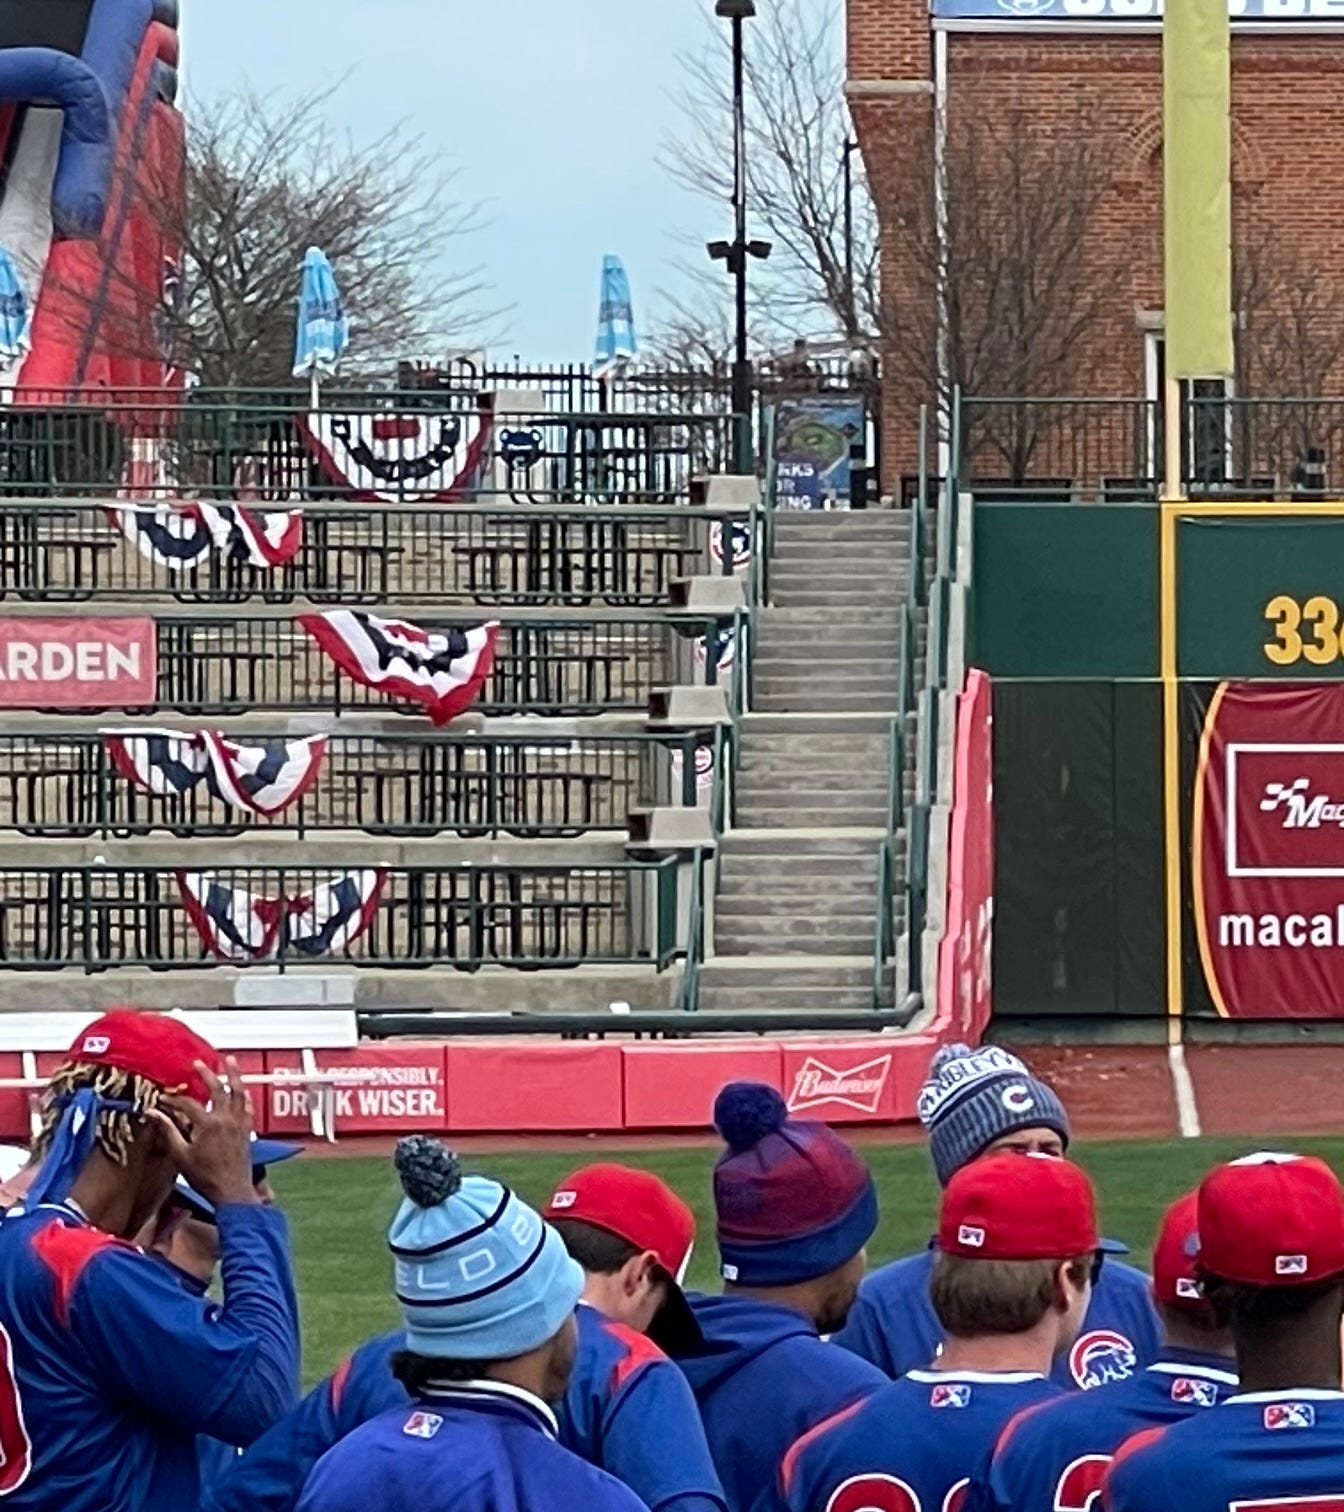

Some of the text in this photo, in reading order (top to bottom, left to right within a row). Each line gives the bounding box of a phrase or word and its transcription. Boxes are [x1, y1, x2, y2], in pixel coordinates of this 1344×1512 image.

[0, 642, 140, 681] RDEN
[273, 1089, 445, 1117] DRK WISER.
